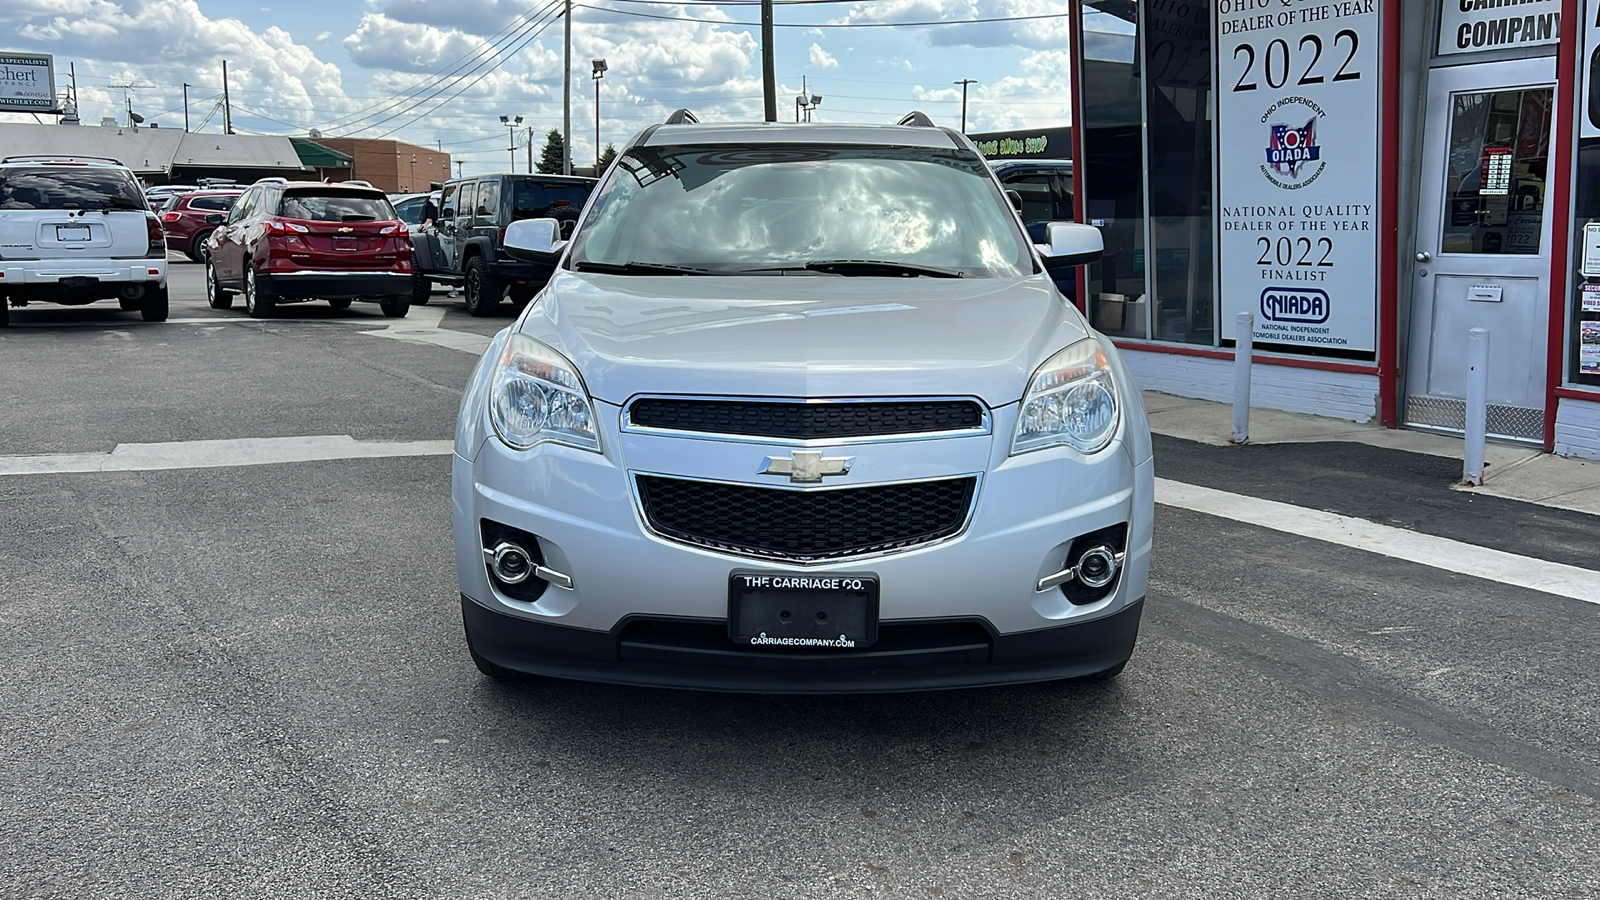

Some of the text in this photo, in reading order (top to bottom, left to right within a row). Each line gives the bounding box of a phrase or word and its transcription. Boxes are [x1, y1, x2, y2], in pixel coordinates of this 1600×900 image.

[1221, 14, 1274, 35] DEALER
[1277, 10, 1296, 27] OF
[1299, 5, 1330, 23] THE
[1333, 0, 1374, 18] YEAR
[1232, 28, 1361, 93] 2022
[0, 66, 37, 82] chert
[1260, 96, 1327, 124] OHIO INDEPENDENT
[1000, 137, 1024, 156] SMOKE
[1025, 135, 1048, 153] SHOP
[1271, 147, 1312, 162] OIADA
[1259, 164, 1282, 189] AUTOMOBILE
[1302, 161, 1327, 187] ASSOCIATION
[1223, 204, 1372, 219] NATIONAL QUALITY
[1224, 220, 1370, 231] DEALER OF THE YEAR
[1255, 236, 1334, 267] 2022
[1261, 269, 1327, 282] FINALIST
[1266, 295, 1323, 316] NIADA
[1261, 323, 1330, 334] NATIONAL INDEPENDENT
[1253, 331, 1348, 345] TOMOBILE DEALERS ASSOCIATION
[743, 577, 865, 590] THE CARRIAGE CO.
[750, 637, 855, 648] CARRIAGECOMPANY.COM
